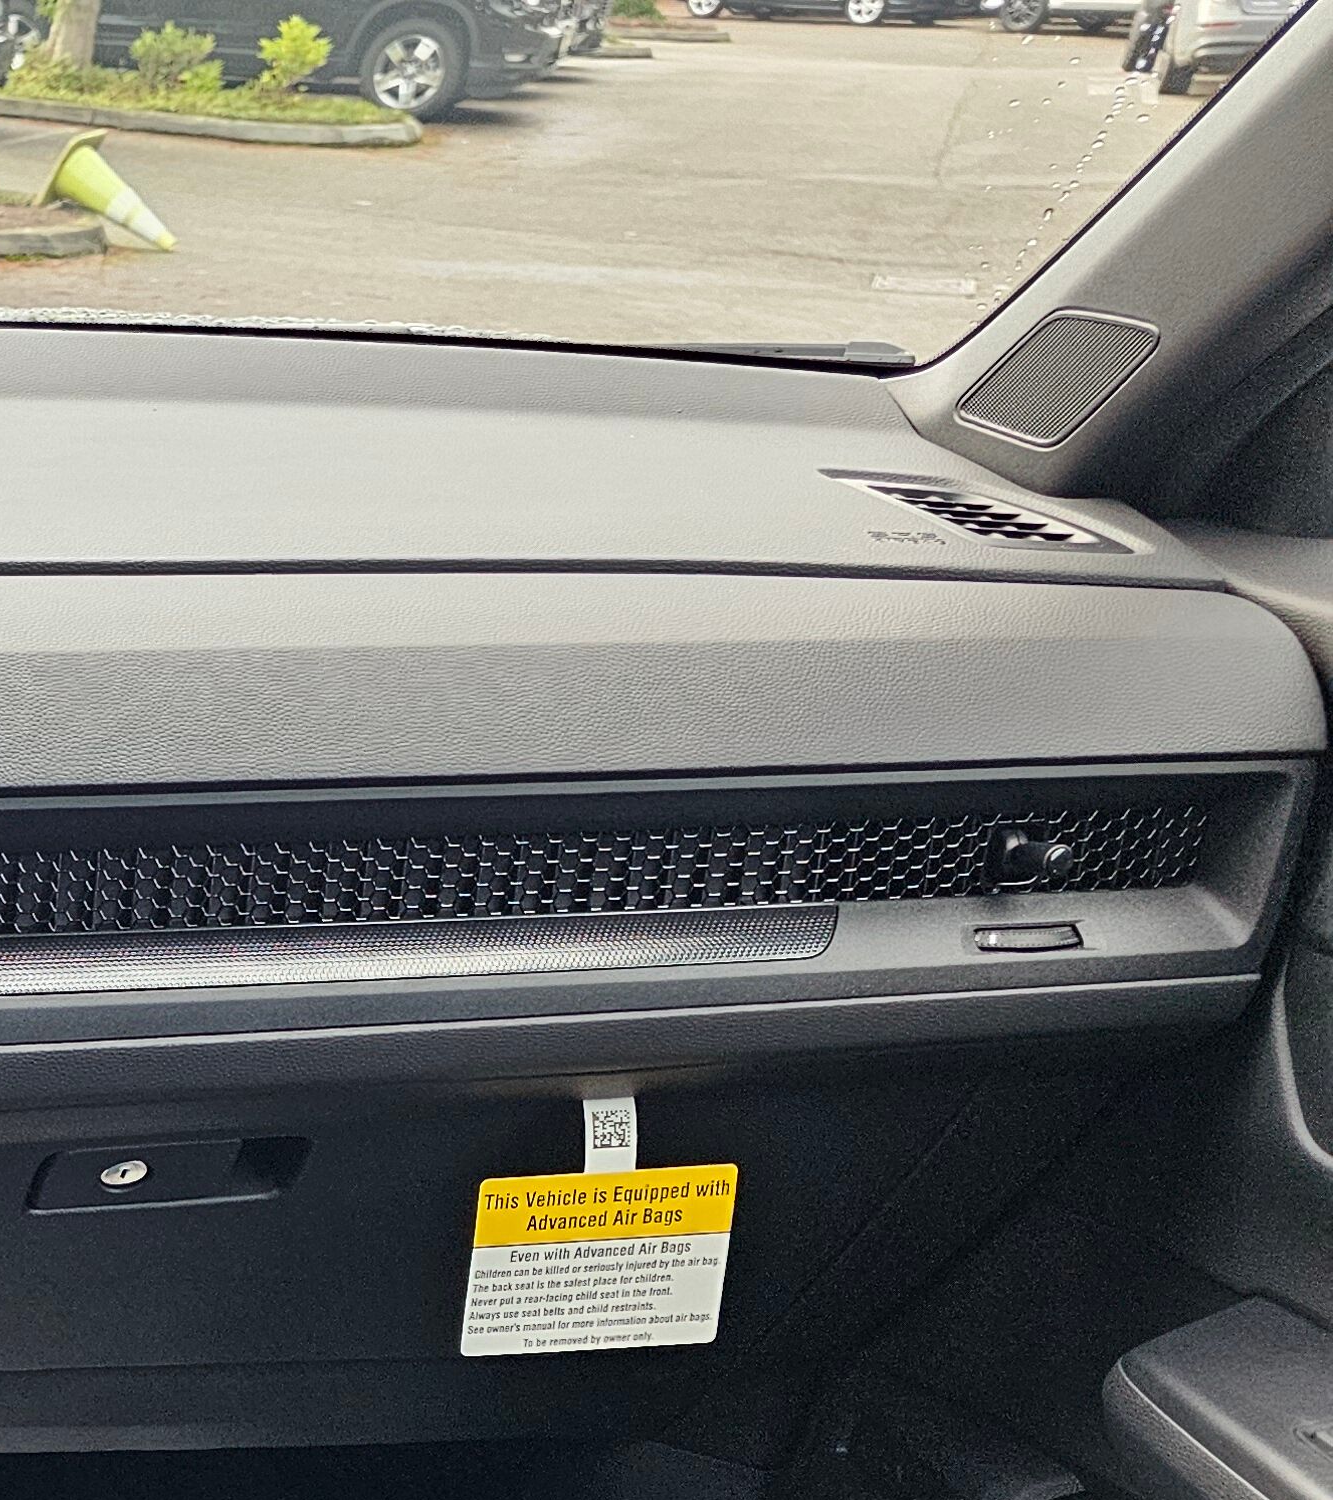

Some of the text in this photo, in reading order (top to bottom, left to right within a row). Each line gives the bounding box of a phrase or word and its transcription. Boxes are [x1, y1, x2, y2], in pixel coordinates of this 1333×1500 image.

[485, 1179, 730, 1210] This Vehicle is Equipped with
[526, 1208, 683, 1231] Advanced Air Bags
[510, 1241, 692, 1263] Even with Advanced Air Bags
[475, 1257, 701, 1279] Children can be killed or seriously injured by the air
[473, 1284, 489, 1293] The
[492, 1283, 513, 1292] back
[515, 1281, 534, 1291] seat
[536, 1280, 545, 1289] is
[547, 1280, 562, 1289] the
[593, 1277, 618, 1287] place
[471, 1298, 498, 1307] Never
[499, 1296, 514, 1307] put
[575, 1290, 597, 1301] child
[599, 1290, 619, 1300] seat
[632, 1288, 647, 1297] the
[469, 1311, 501, 1322] Always
[503, 1310, 519, 1319] use
[521, 1309, 541, 1318] seat
[543, 1307, 565, 1317] belts
[567, 1306, 584, 1315] and
[586, 1303, 609, 1313] child
[468, 1325, 485, 1335] See
[523, 1321, 556, 1332] manual
[572, 1319, 594, 1329] more
[648, 1315, 674, 1325] about
[675, 1313, 688, 1323] air
[549, 1335, 588, 1346] removed
